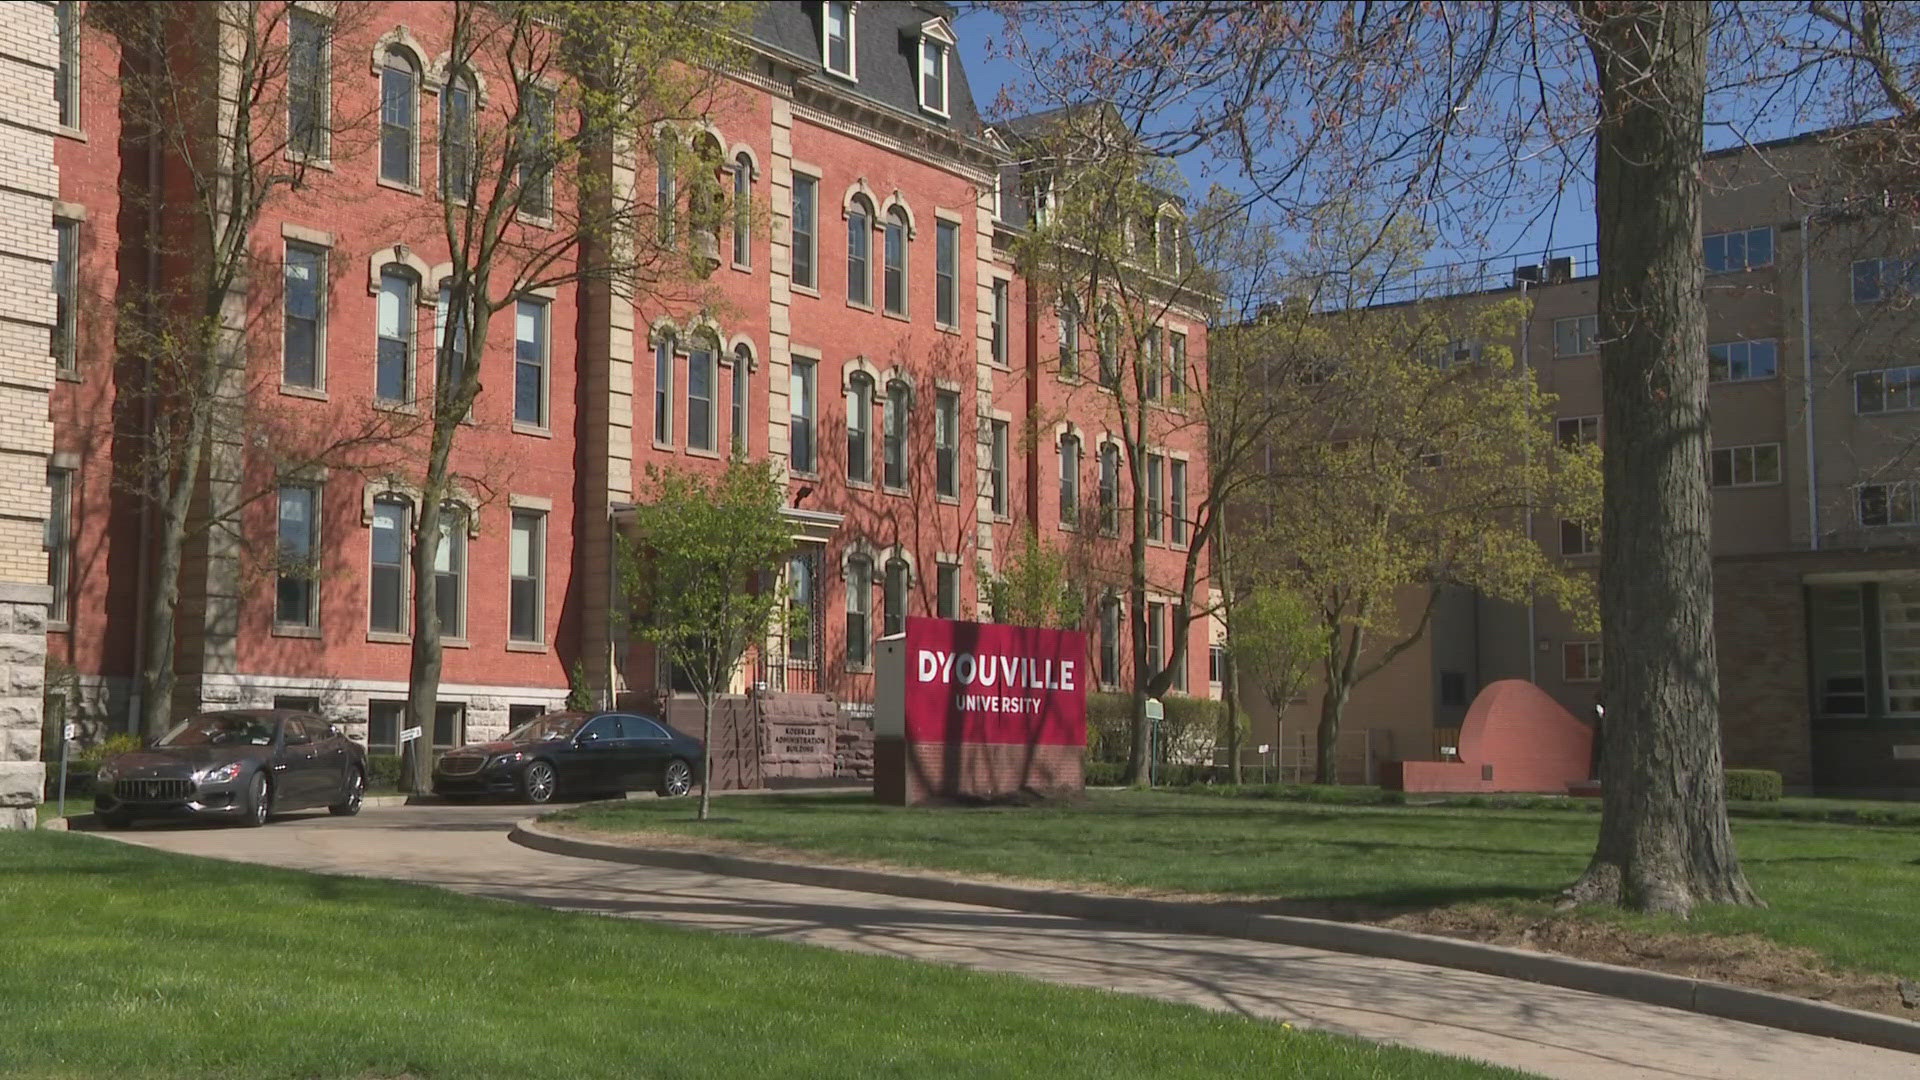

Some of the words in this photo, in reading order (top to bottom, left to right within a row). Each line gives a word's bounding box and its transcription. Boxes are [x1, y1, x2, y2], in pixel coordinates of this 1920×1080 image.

[918, 650, 1074, 691] DYOUVILLE
[956, 694, 1041, 714] UNIVERSITY
[775, 736, 825, 744] ADMINISTRATION
